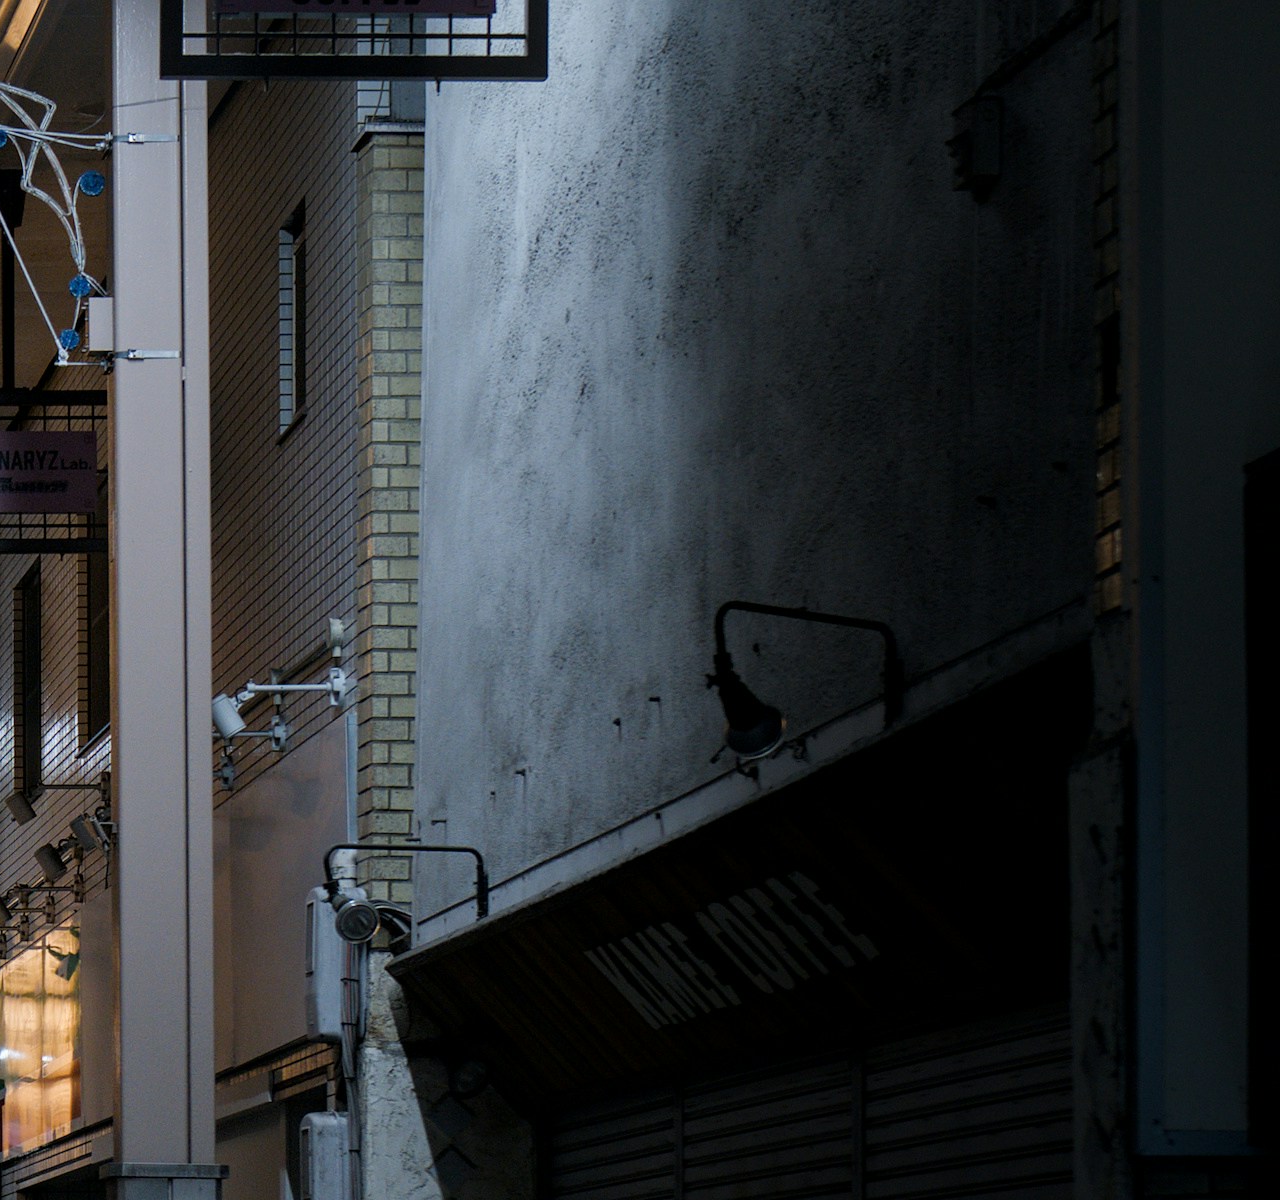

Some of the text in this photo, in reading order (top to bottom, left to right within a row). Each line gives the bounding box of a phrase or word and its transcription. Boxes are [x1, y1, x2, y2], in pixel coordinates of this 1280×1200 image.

[60, 457, 93, 471] Lab.
[582, 869, 881, 1031] KAMEE COFFEE
